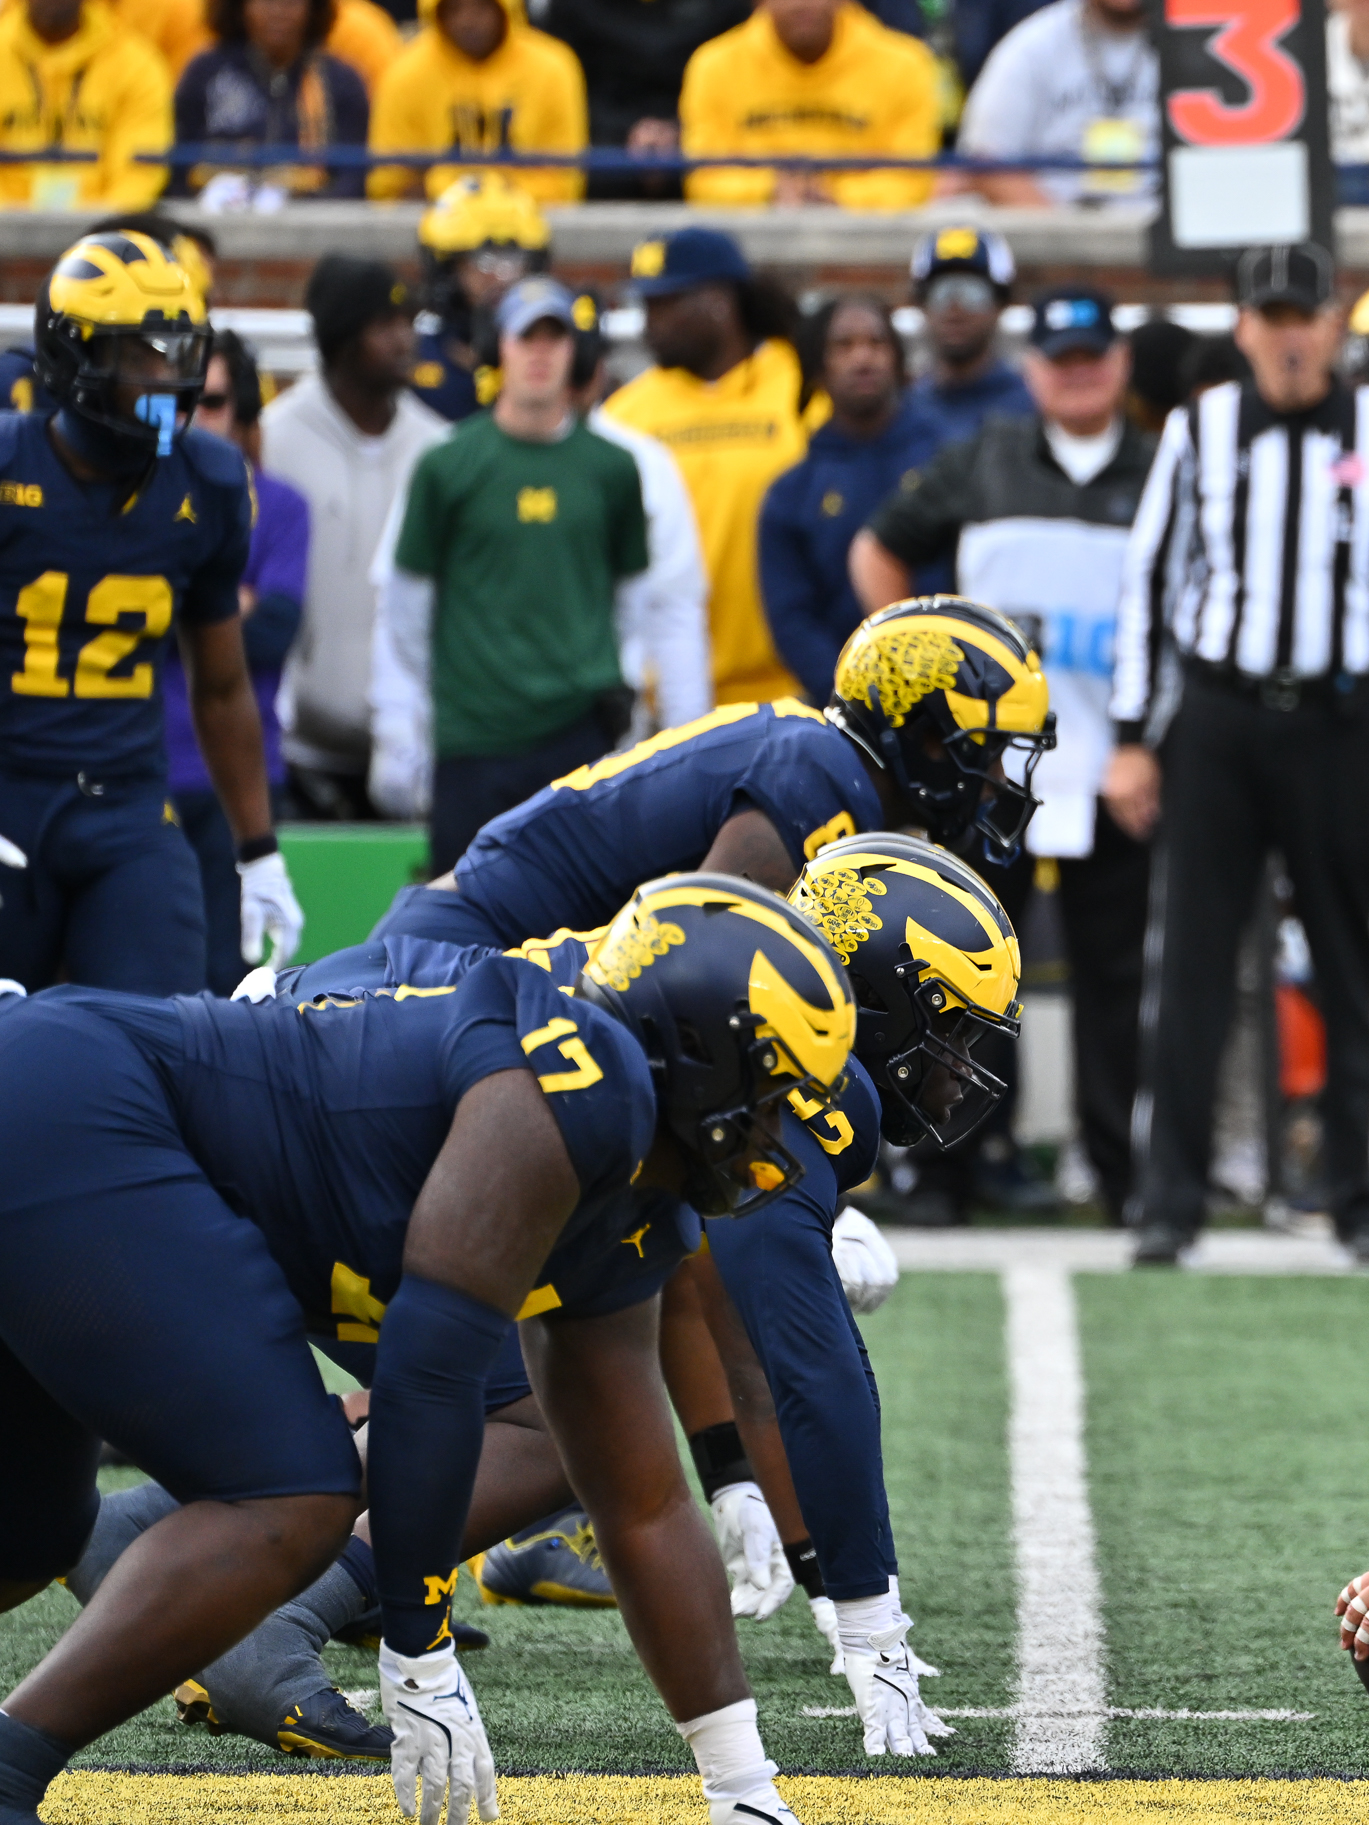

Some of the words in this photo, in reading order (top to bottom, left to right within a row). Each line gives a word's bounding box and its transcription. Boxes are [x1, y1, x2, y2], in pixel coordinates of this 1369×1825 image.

[1165, 0, 1304, 145] 3
[11, 570, 173, 698] 12
[520, 1017, 604, 1093] 17
[423, 1566, 458, 1606] M
